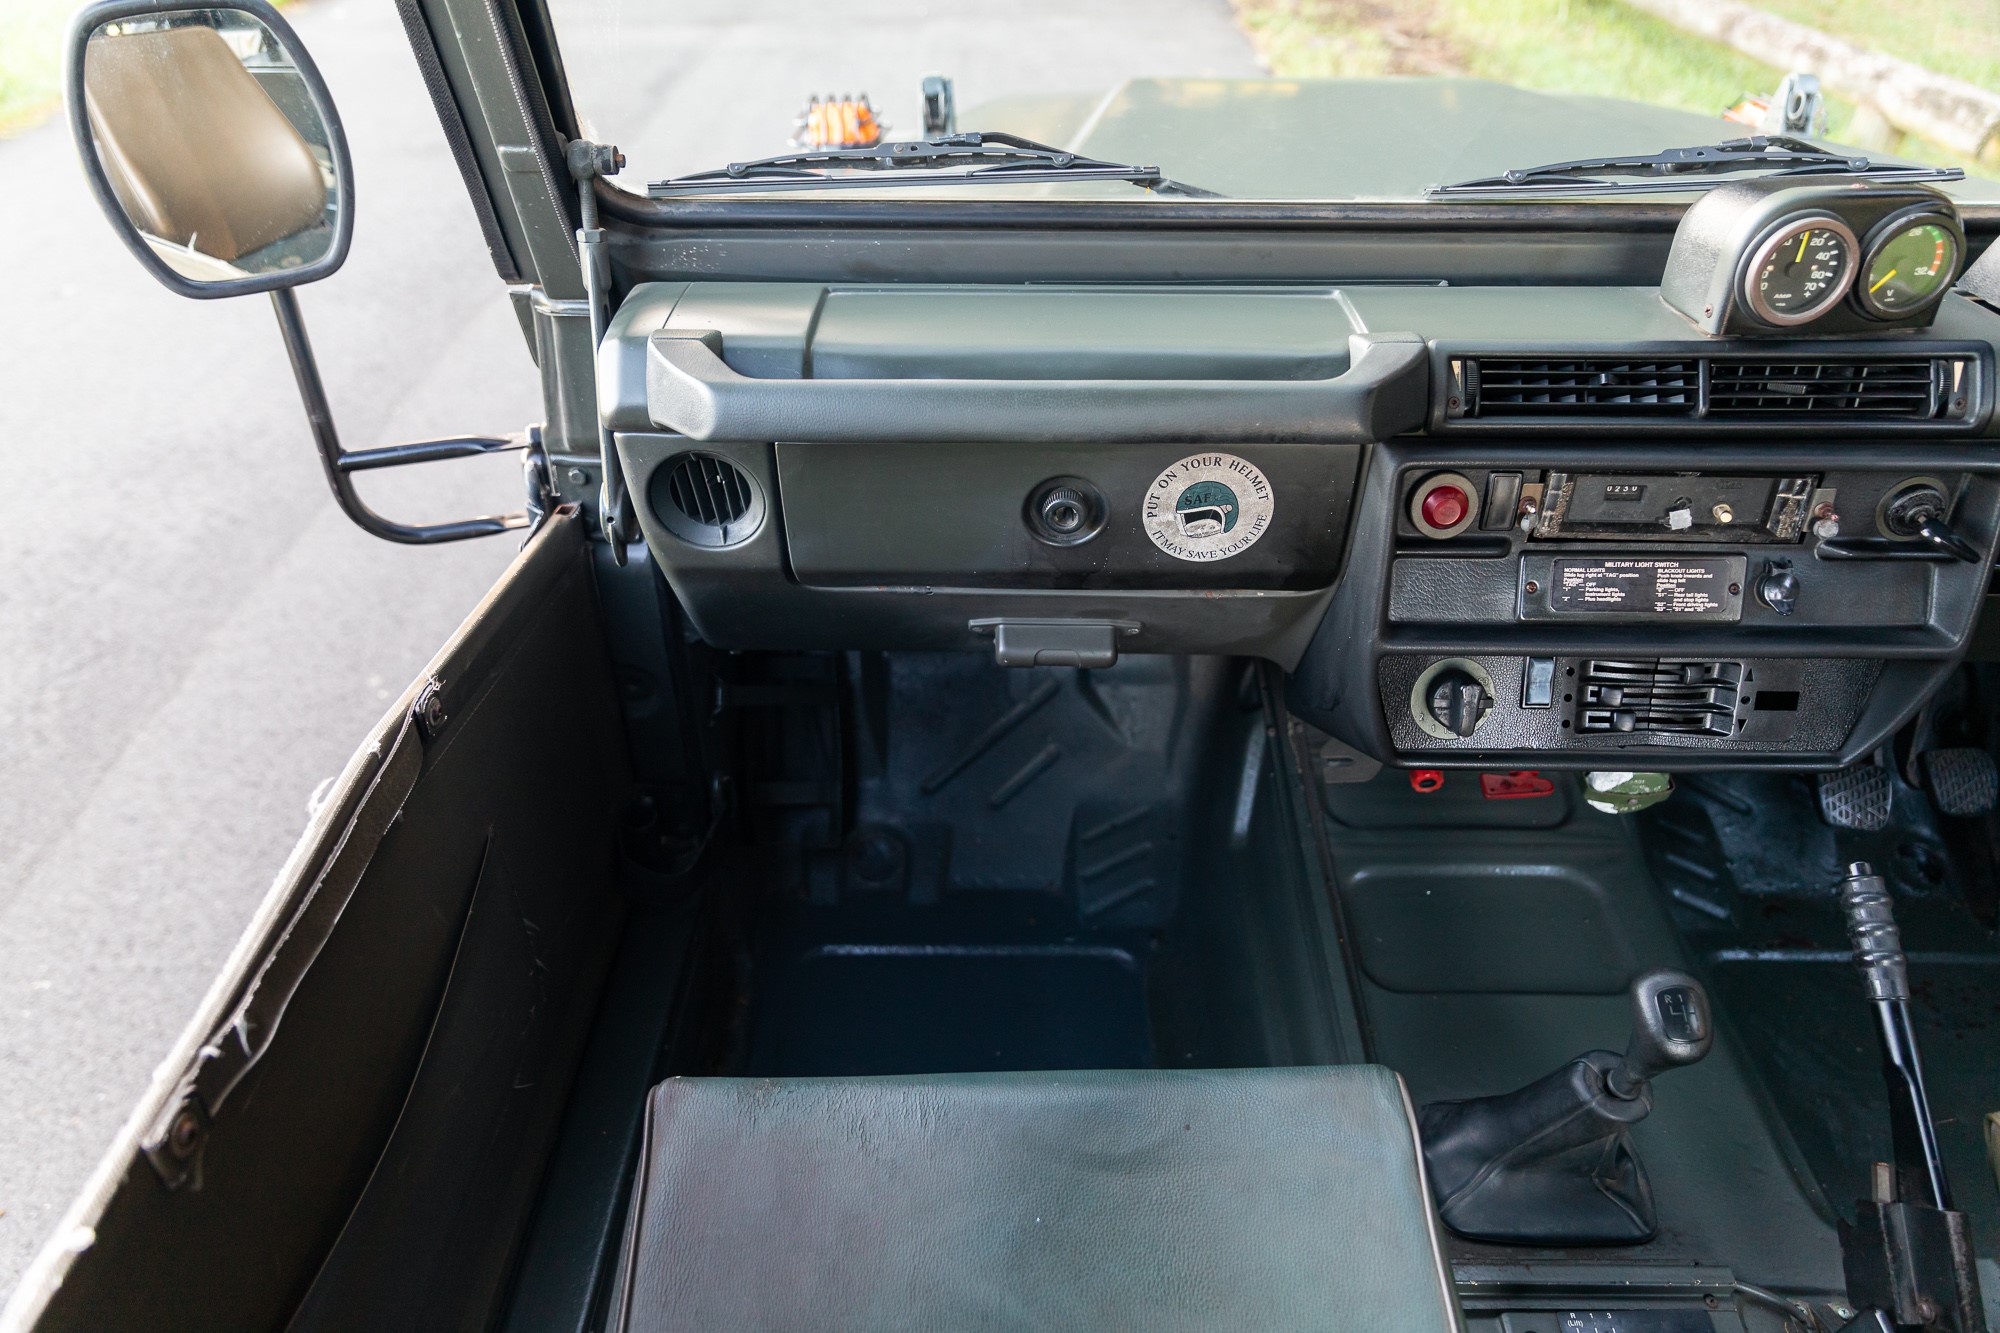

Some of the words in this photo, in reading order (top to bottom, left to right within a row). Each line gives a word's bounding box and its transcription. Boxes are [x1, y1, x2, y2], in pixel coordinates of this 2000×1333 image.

[1810, 238, 1825, 246] 20
[1815, 252, 1830, 260] 40
[1811, 271, 1825, 279] 60
[1914, 266, 1928, 276] 32
[1804, 283, 1817, 291] 70
[1146, 493, 1160, 519] PUT
[1158, 470, 1178, 489] ON
[1181, 456, 1222, 472] YOUR
[1228, 460, 1269, 501] HELMET
[1184, 493, 1212, 506] SAF
[1152, 530, 1162, 541] IT
[1160, 539, 1186, 555] MAY
[1186, 550, 1218, 559] SAVE
[1220, 536, 1252, 556] YOUR
[1249, 514, 1268, 537] LIFE
[1664, 994, 1672, 1004] R
